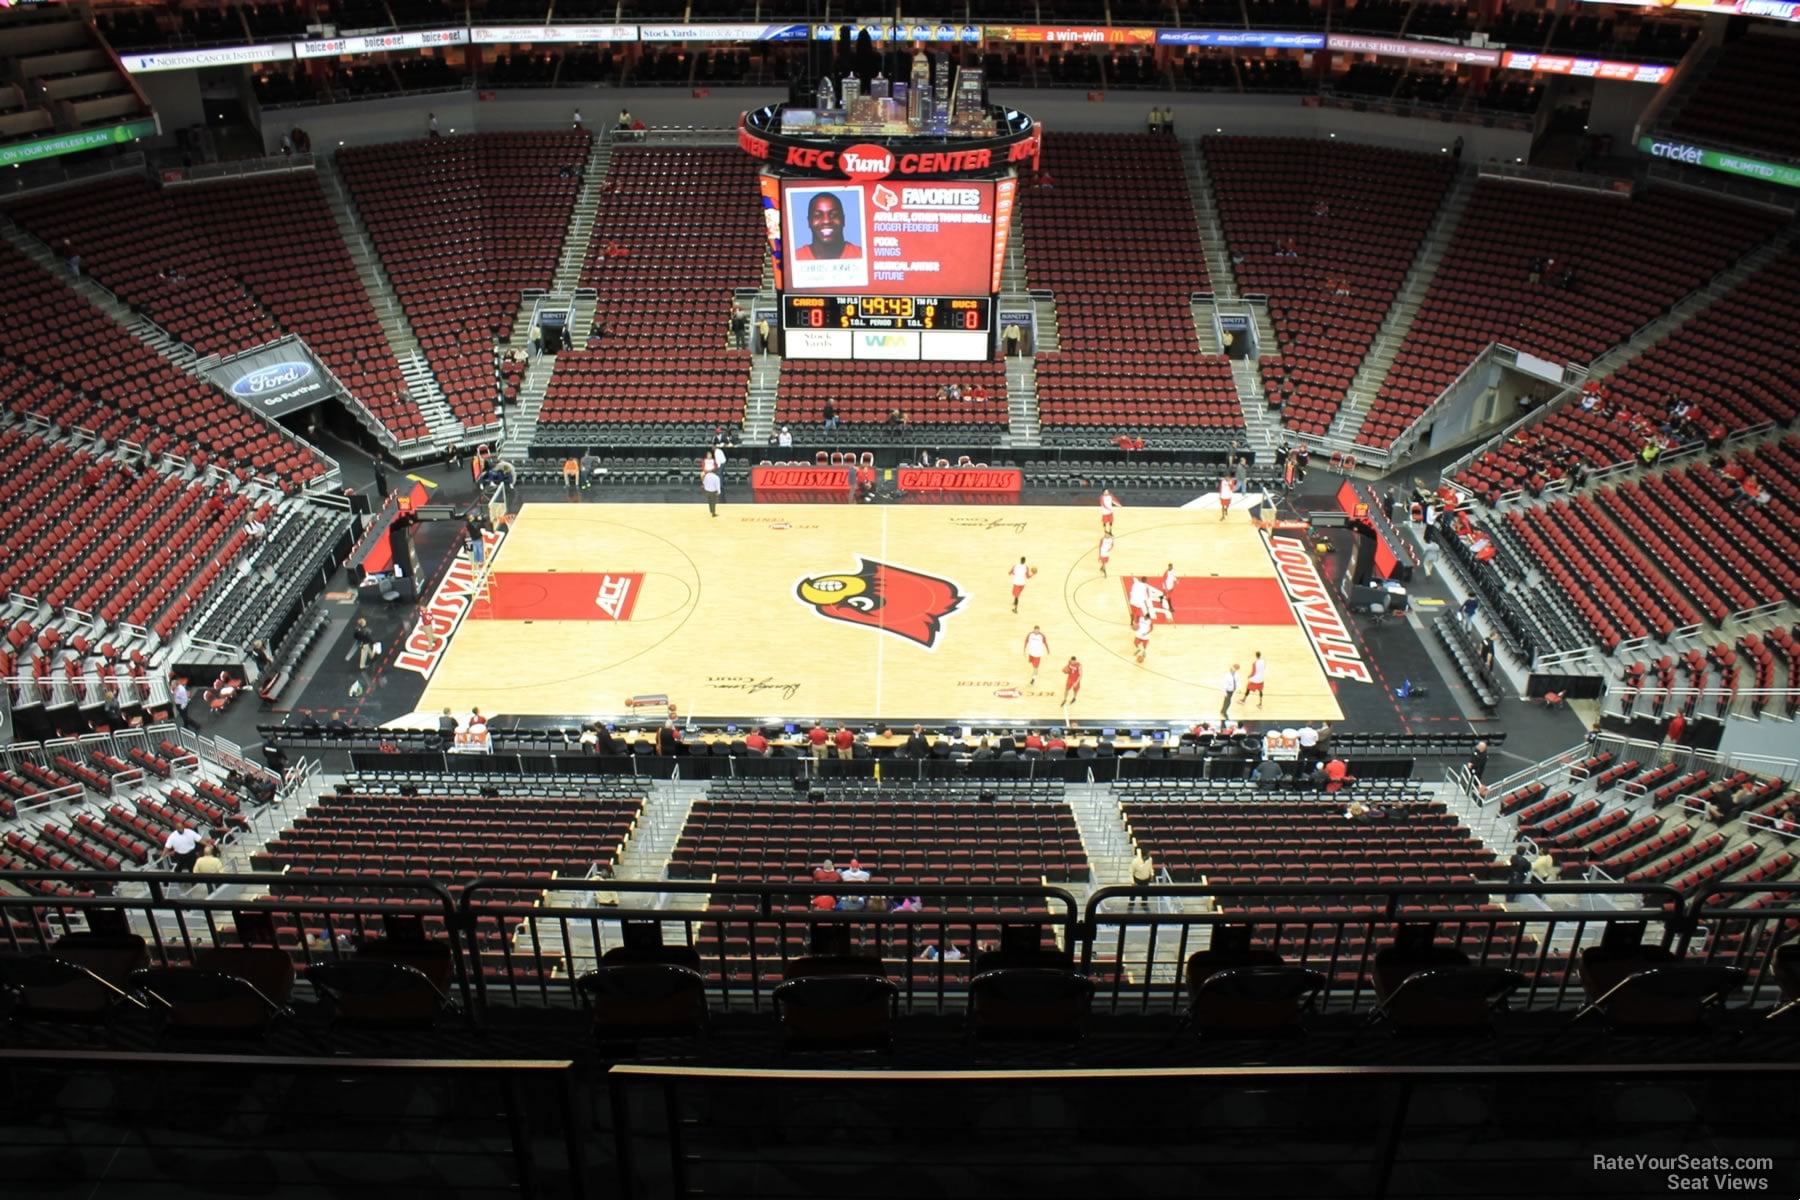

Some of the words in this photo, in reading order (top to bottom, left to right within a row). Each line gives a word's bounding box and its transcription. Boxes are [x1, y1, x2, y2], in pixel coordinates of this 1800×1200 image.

[643, 30, 669, 38] Stock
[671, 30, 697, 38] Yards
[1046, 31, 1055, 41] a
[1057, 30, 1104, 41] win-win
[1329, 38, 1351, 48] GALT
[1351, 40, 1378, 51] HOUSE
[1379, 43, 1406, 53] HOTEL
[156, 57, 197, 67] NORTON
[196, 53, 232, 64] CANCER
[233, 50, 275, 60] INSTITUTE
[3, 152, 17, 160] ON
[19, 147, 43, 156] YOUR
[44, 139, 85, 151] WIRELESS
[86, 133, 108, 144] PLAN
[1651, 142, 1704, 164] cricket
[786, 146, 834, 170] KFC
[843, 153, 892, 173] Yum!
[900, 149, 991, 174] CENTER
[1719, 157, 1774, 177] UNLIMITED
[902, 188, 980, 205] FAVORITES
[874, 223, 901, 232] ROGER
[902, 223, 938, 232] FEDERER
[874, 248, 901, 257] WINGS
[874, 272, 904, 280] FUTURE
[793, 298, 824, 306] CARDS
[862, 297, 912, 315] 49:43
[811, 309, 822, 326] 0
[966, 311, 977, 328] 0
[249, 367, 299, 393] Ford
[264, 397, 282, 406] Go
[281, 383, 321, 400] Further
[761, 470, 849, 486] LOUISVIL
[902, 472, 1013, 488] CARDINALS
[393, 528, 505, 680] LOUISVILE
[595, 575, 632, 620] ACC
[1267, 535, 1373, 684] LOUISVILLE
